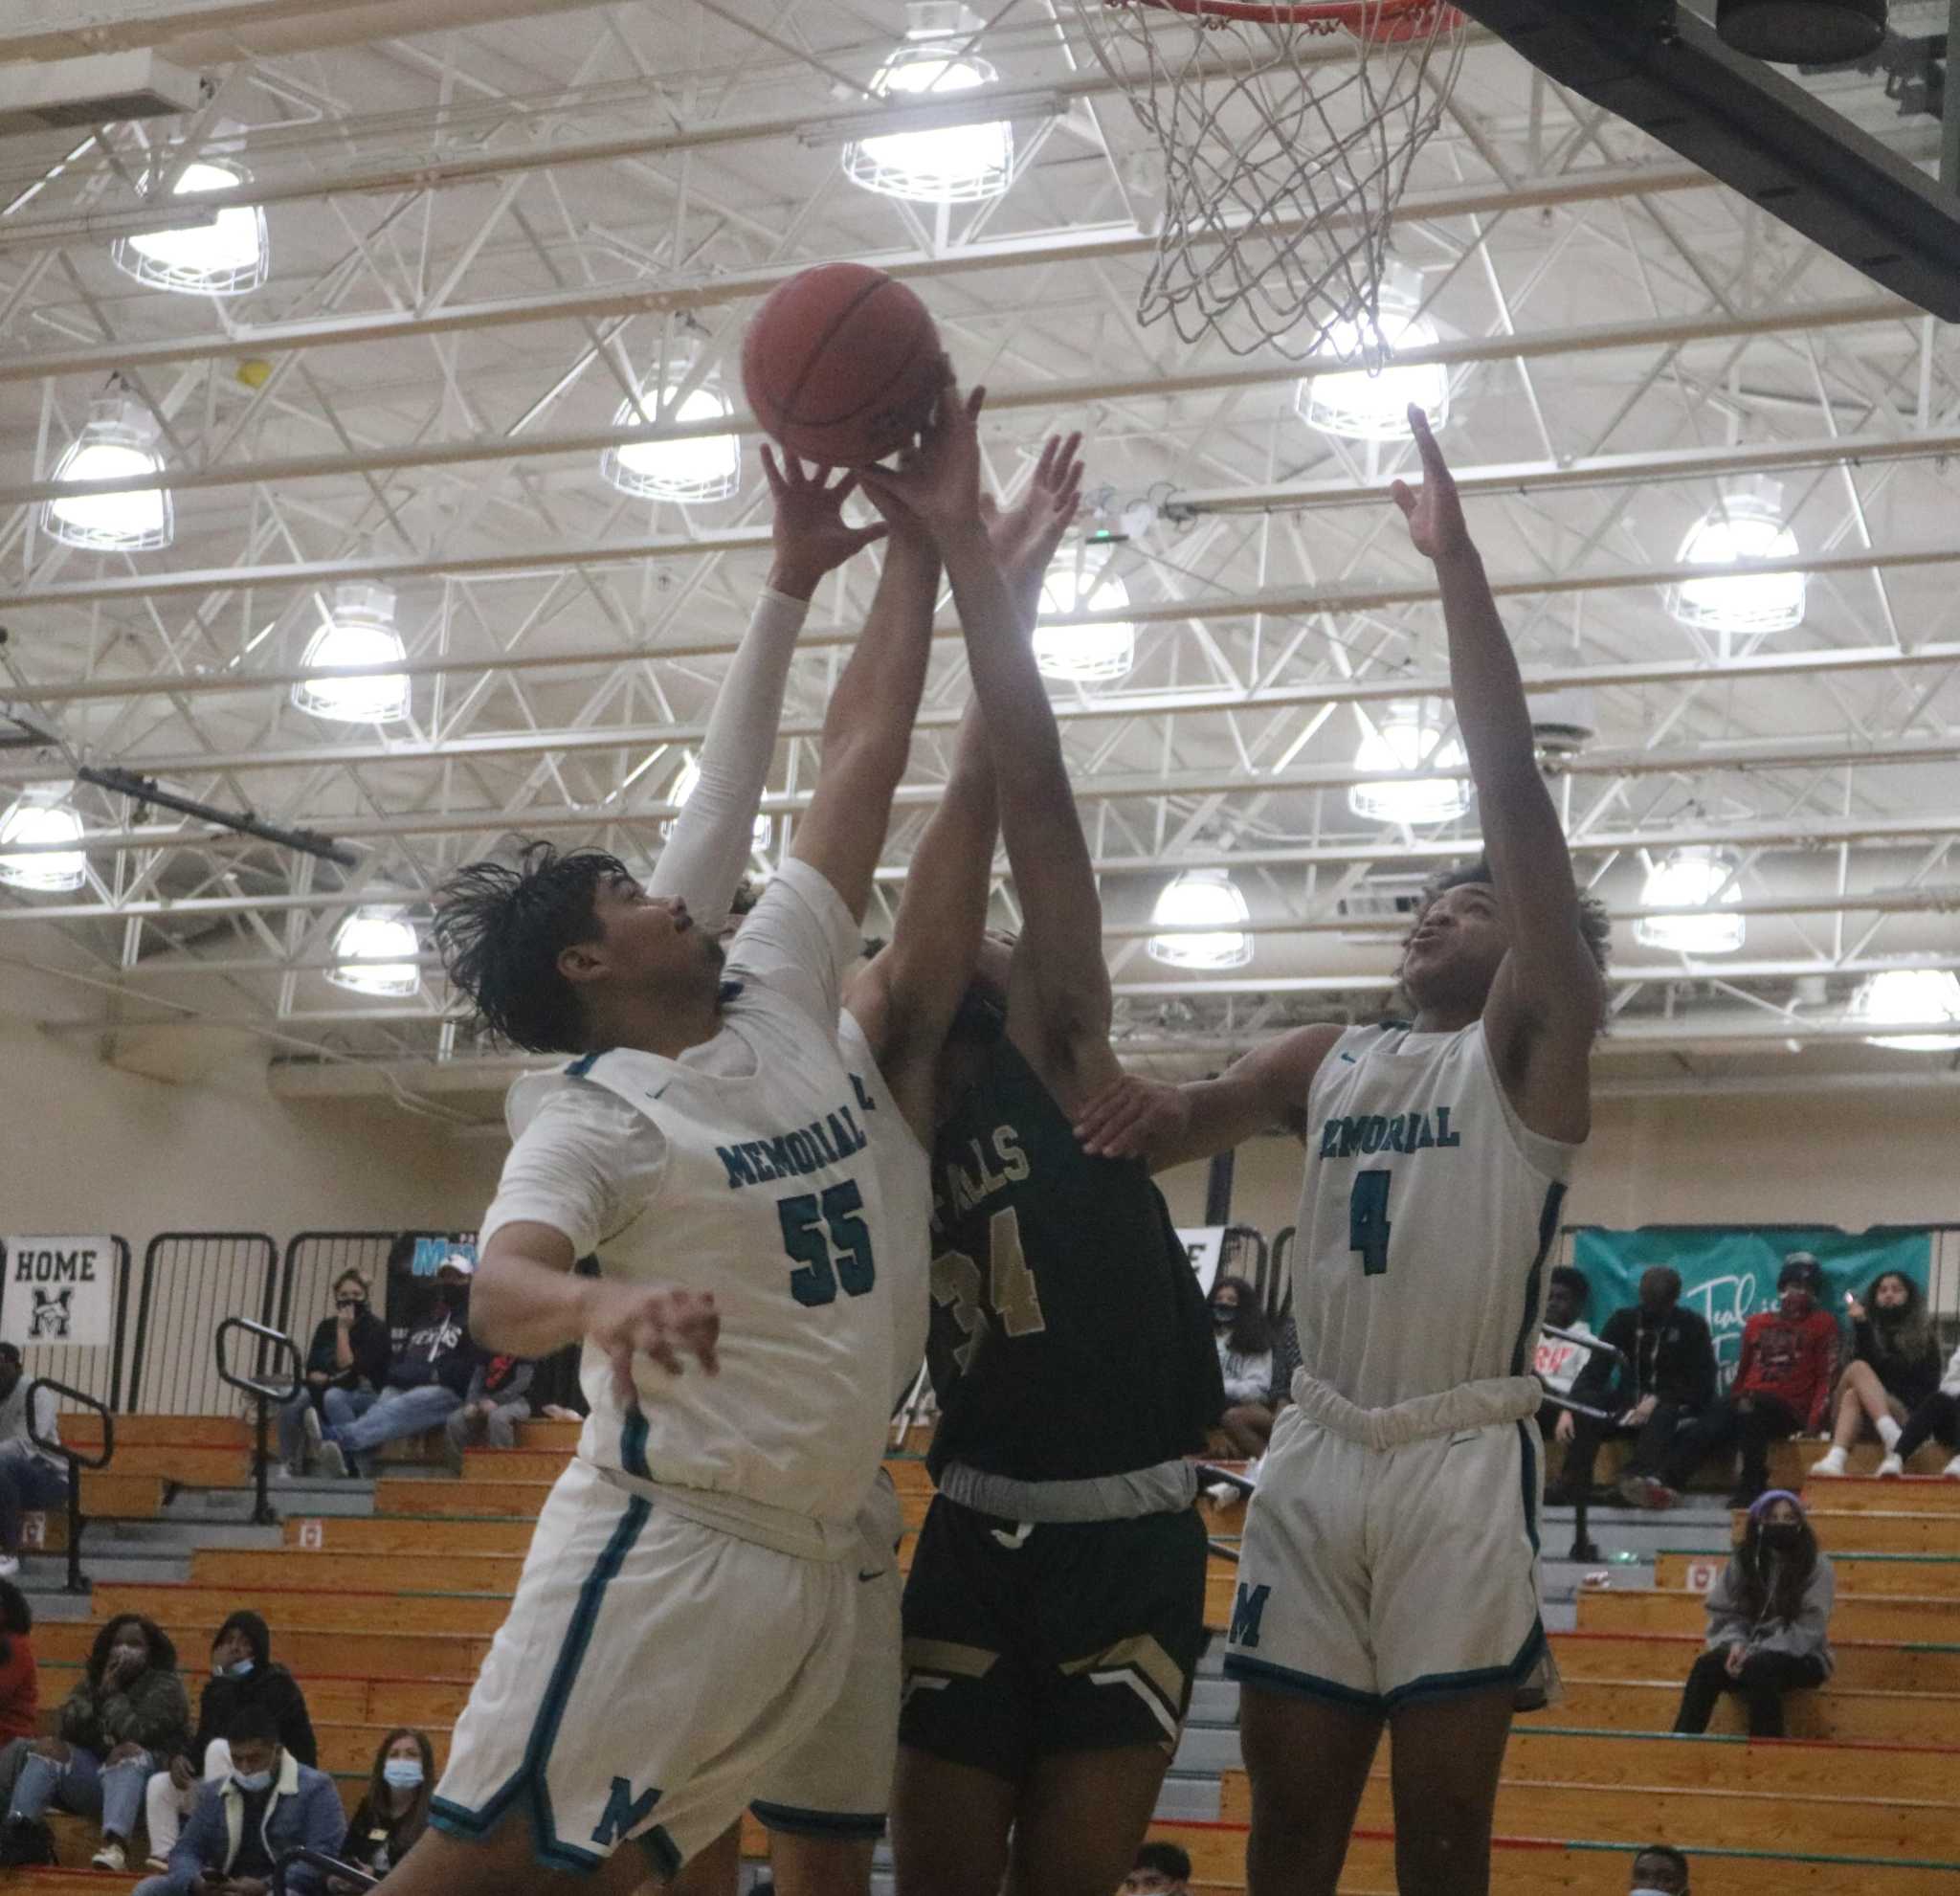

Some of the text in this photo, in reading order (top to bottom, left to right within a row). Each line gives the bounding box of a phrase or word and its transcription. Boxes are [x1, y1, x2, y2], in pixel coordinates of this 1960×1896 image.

[776, 1178, 876, 1308] 55
[1349, 1169, 1392, 1277] 4
[15, 1249, 98, 1283] HOME
[1686, 1273, 1756, 1337] Teal
[1229, 1582, 1272, 1648] M
